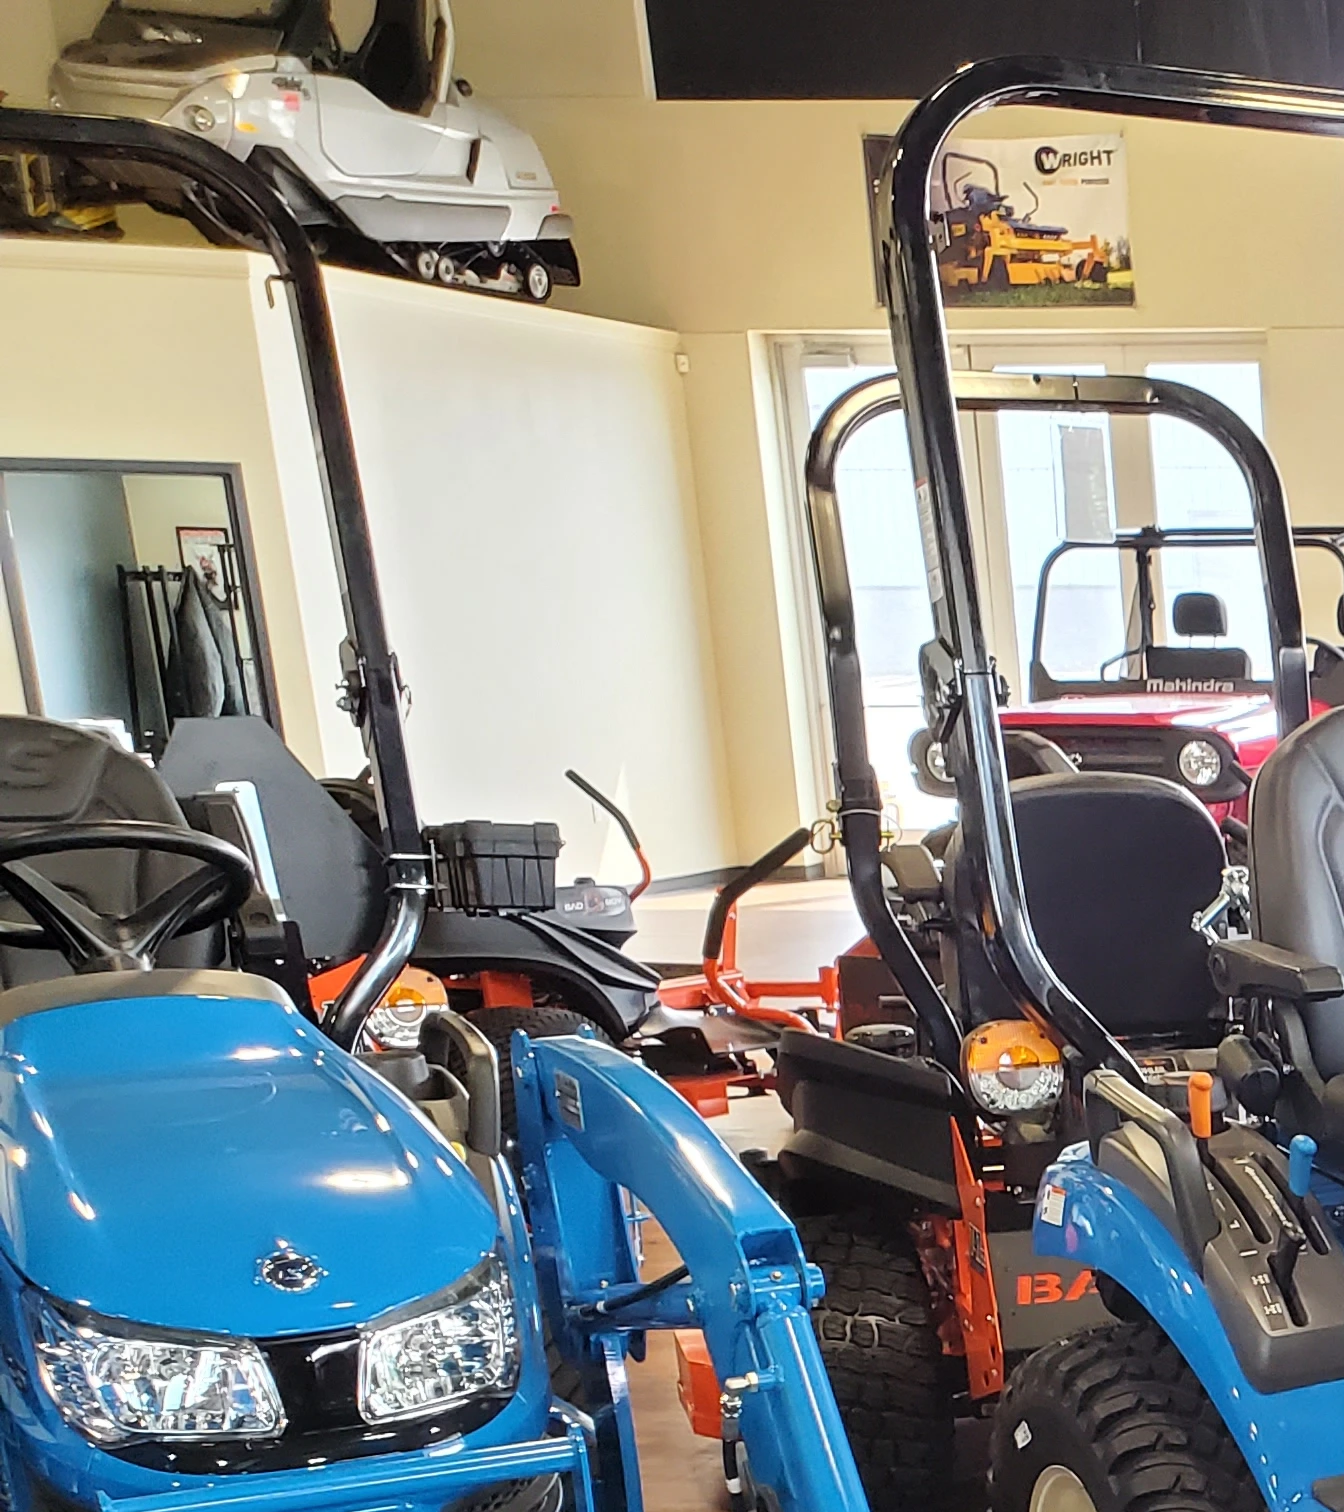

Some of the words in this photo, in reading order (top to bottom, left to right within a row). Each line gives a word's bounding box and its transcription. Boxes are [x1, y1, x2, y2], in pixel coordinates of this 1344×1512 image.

[1034, 146, 1116, 175] WRIGHT
[1146, 678, 1234, 693] Mahindra
[564, 901, 584, 912] BAD
